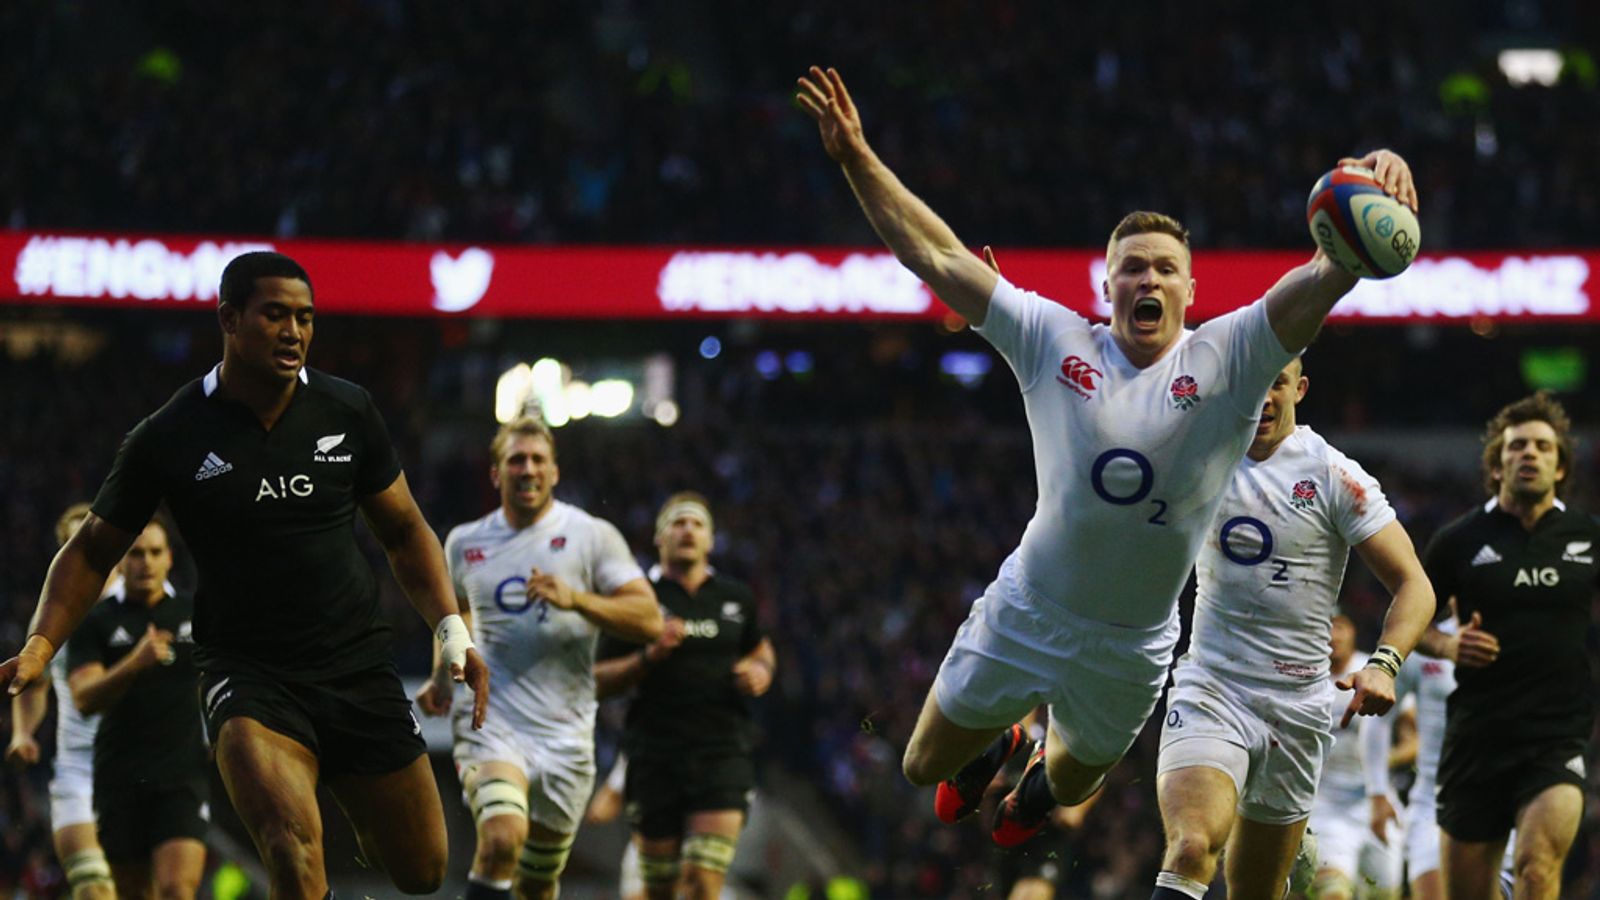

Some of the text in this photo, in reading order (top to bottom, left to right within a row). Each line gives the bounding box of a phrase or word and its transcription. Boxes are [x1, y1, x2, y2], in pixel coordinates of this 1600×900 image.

[14, 235, 276, 299] #ENGvN
[195, 462, 233, 481] adidas
[255, 474, 314, 501] AIG
[1513, 567, 1560, 587] AIG
